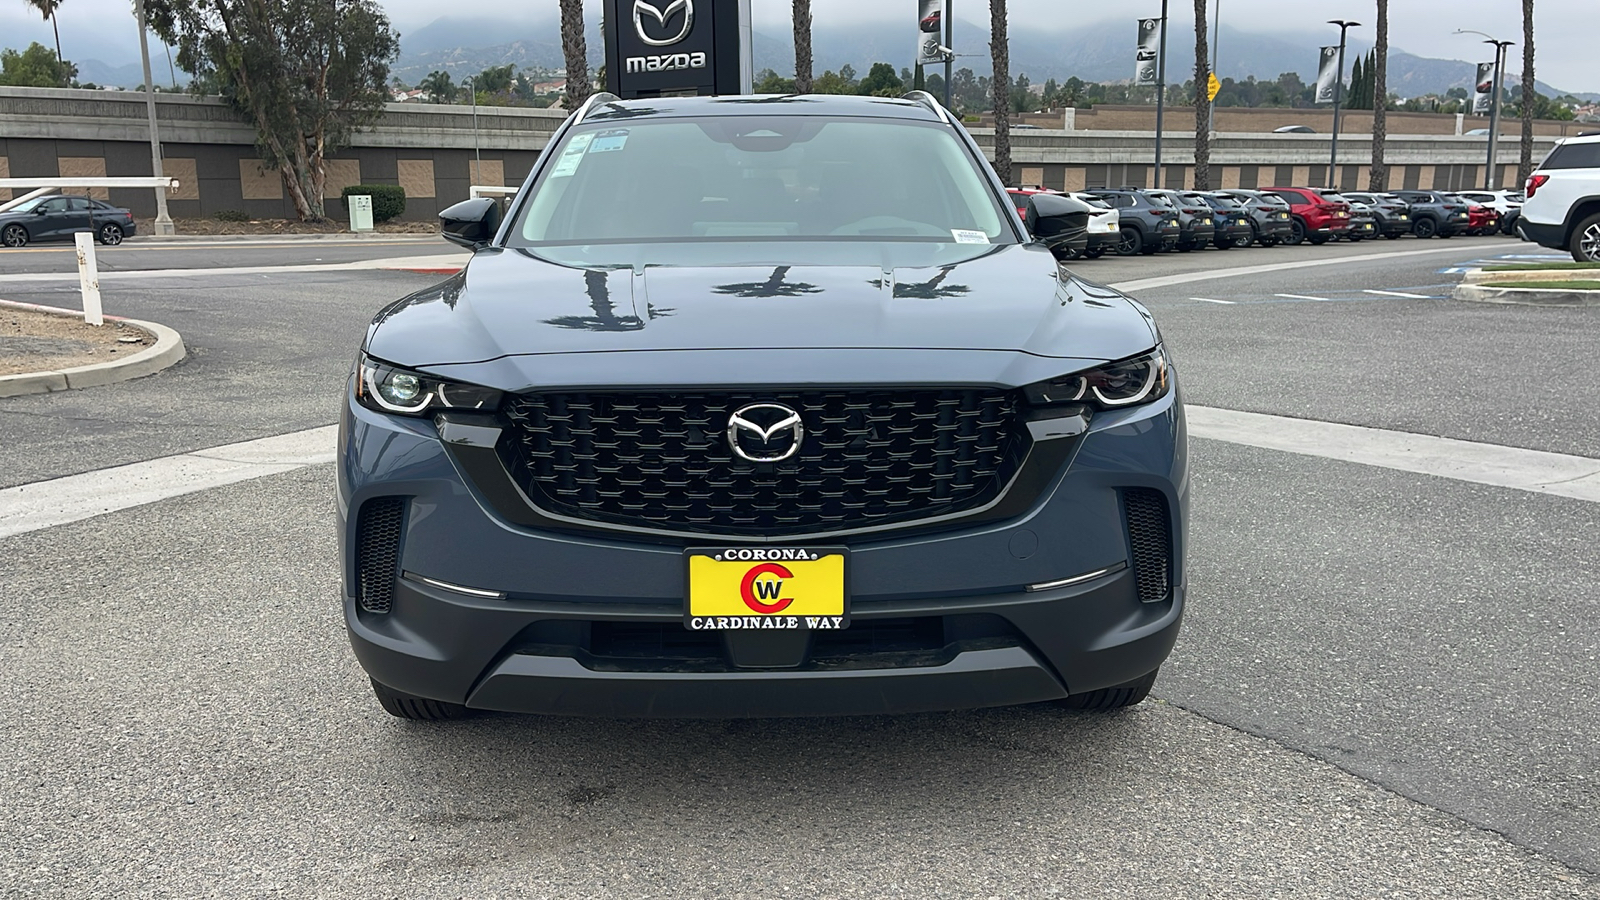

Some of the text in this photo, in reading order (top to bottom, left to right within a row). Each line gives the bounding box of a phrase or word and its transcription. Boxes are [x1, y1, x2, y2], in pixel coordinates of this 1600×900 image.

[724, 549, 810, 560] CORONA
[691, 616, 843, 630] CARDINALE WAY
